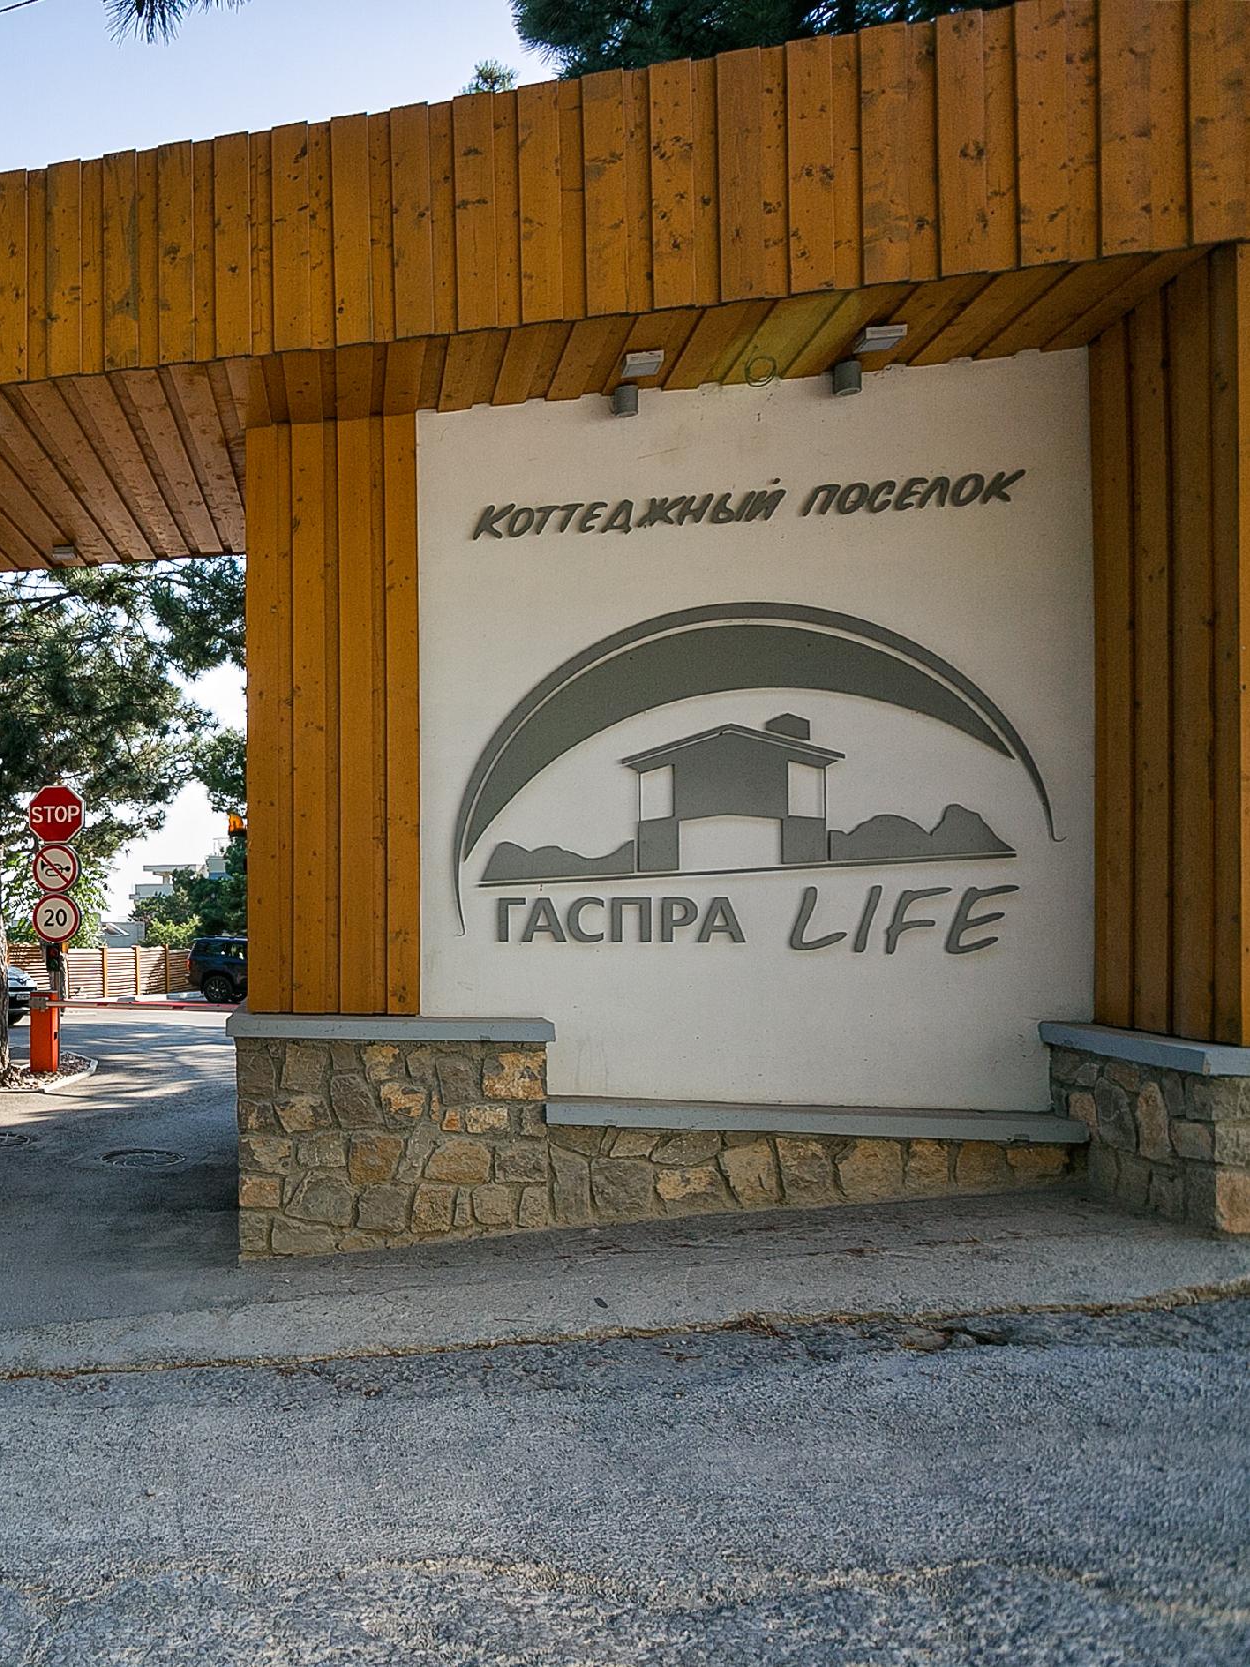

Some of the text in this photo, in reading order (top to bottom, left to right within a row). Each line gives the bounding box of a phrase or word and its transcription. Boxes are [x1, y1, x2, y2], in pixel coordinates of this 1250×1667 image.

[472, 469, 1026, 541] КОТТЕДЖНЫЙ ПОСЕЛОК
[31, 805, 80, 823] STOP
[43, 908, 68, 927] 20
[497, 884, 1020, 955] ГАСПРА LIFE
